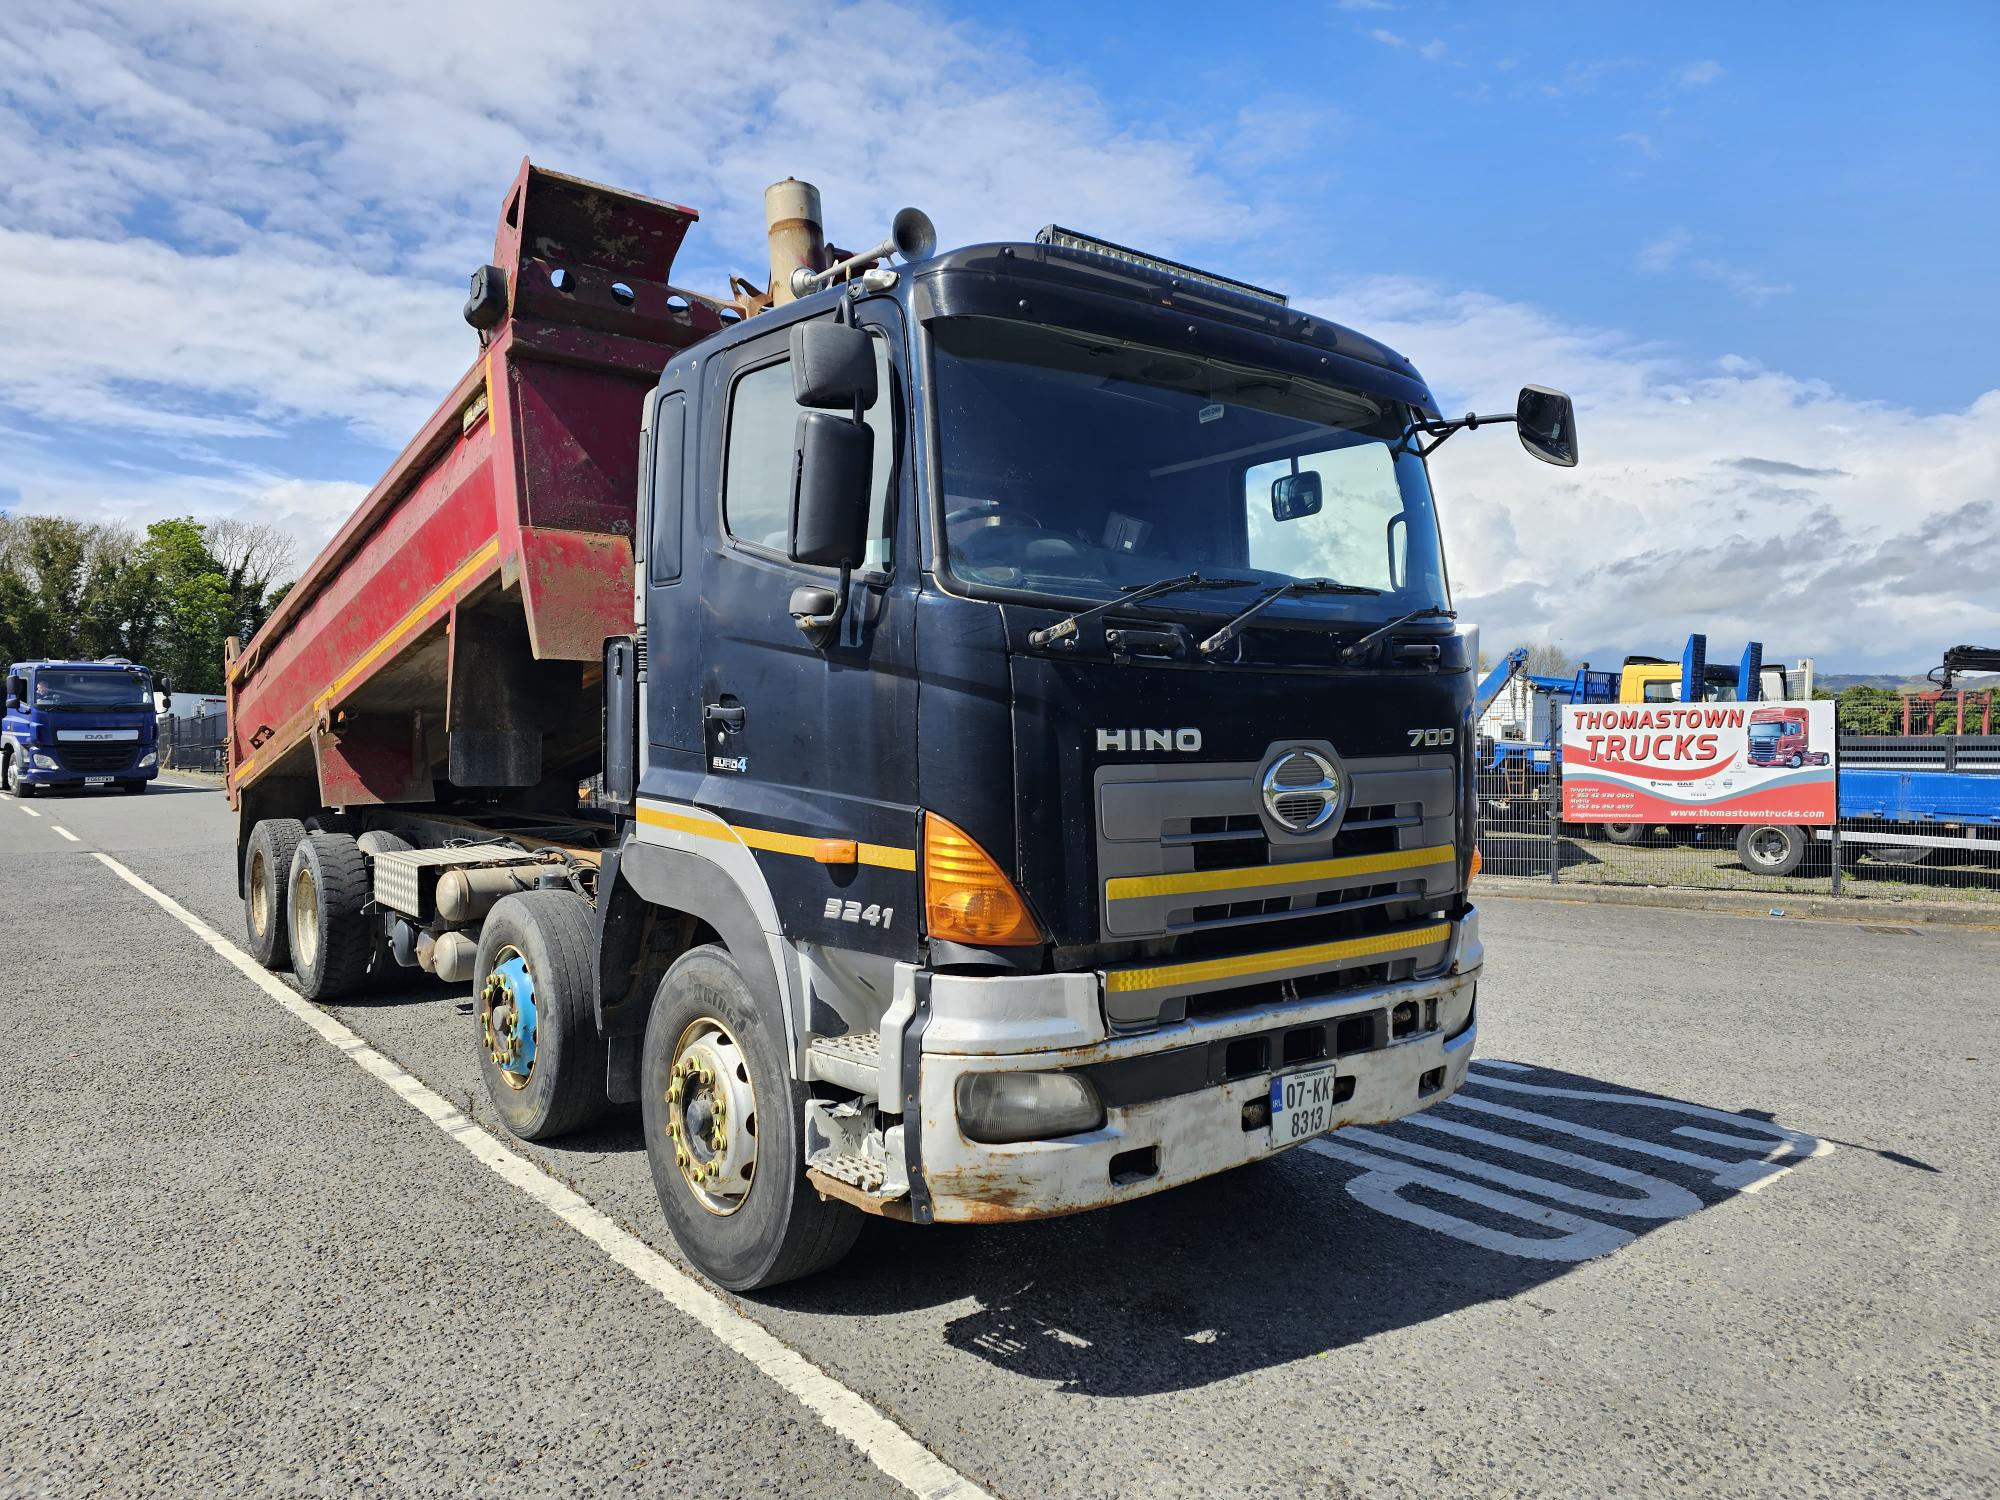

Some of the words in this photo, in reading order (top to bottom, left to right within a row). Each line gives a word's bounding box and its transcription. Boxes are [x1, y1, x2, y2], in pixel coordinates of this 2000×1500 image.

[1574, 709, 1744, 729] THOMASTOWN
[1097, 728, 1202, 751] HINO
[1407, 728, 1455, 746] 700
[1586, 734, 1718, 761] TRUCKS
[1670, 808, 1825, 818] www.thomastowntrucks.com
[824, 898, 893, 929] 3241
[1272, 1099, 1282, 1108] IRL
[1286, 1075, 1330, 1109] 07-KK
[1291, 1106, 1323, 1138] 8313
